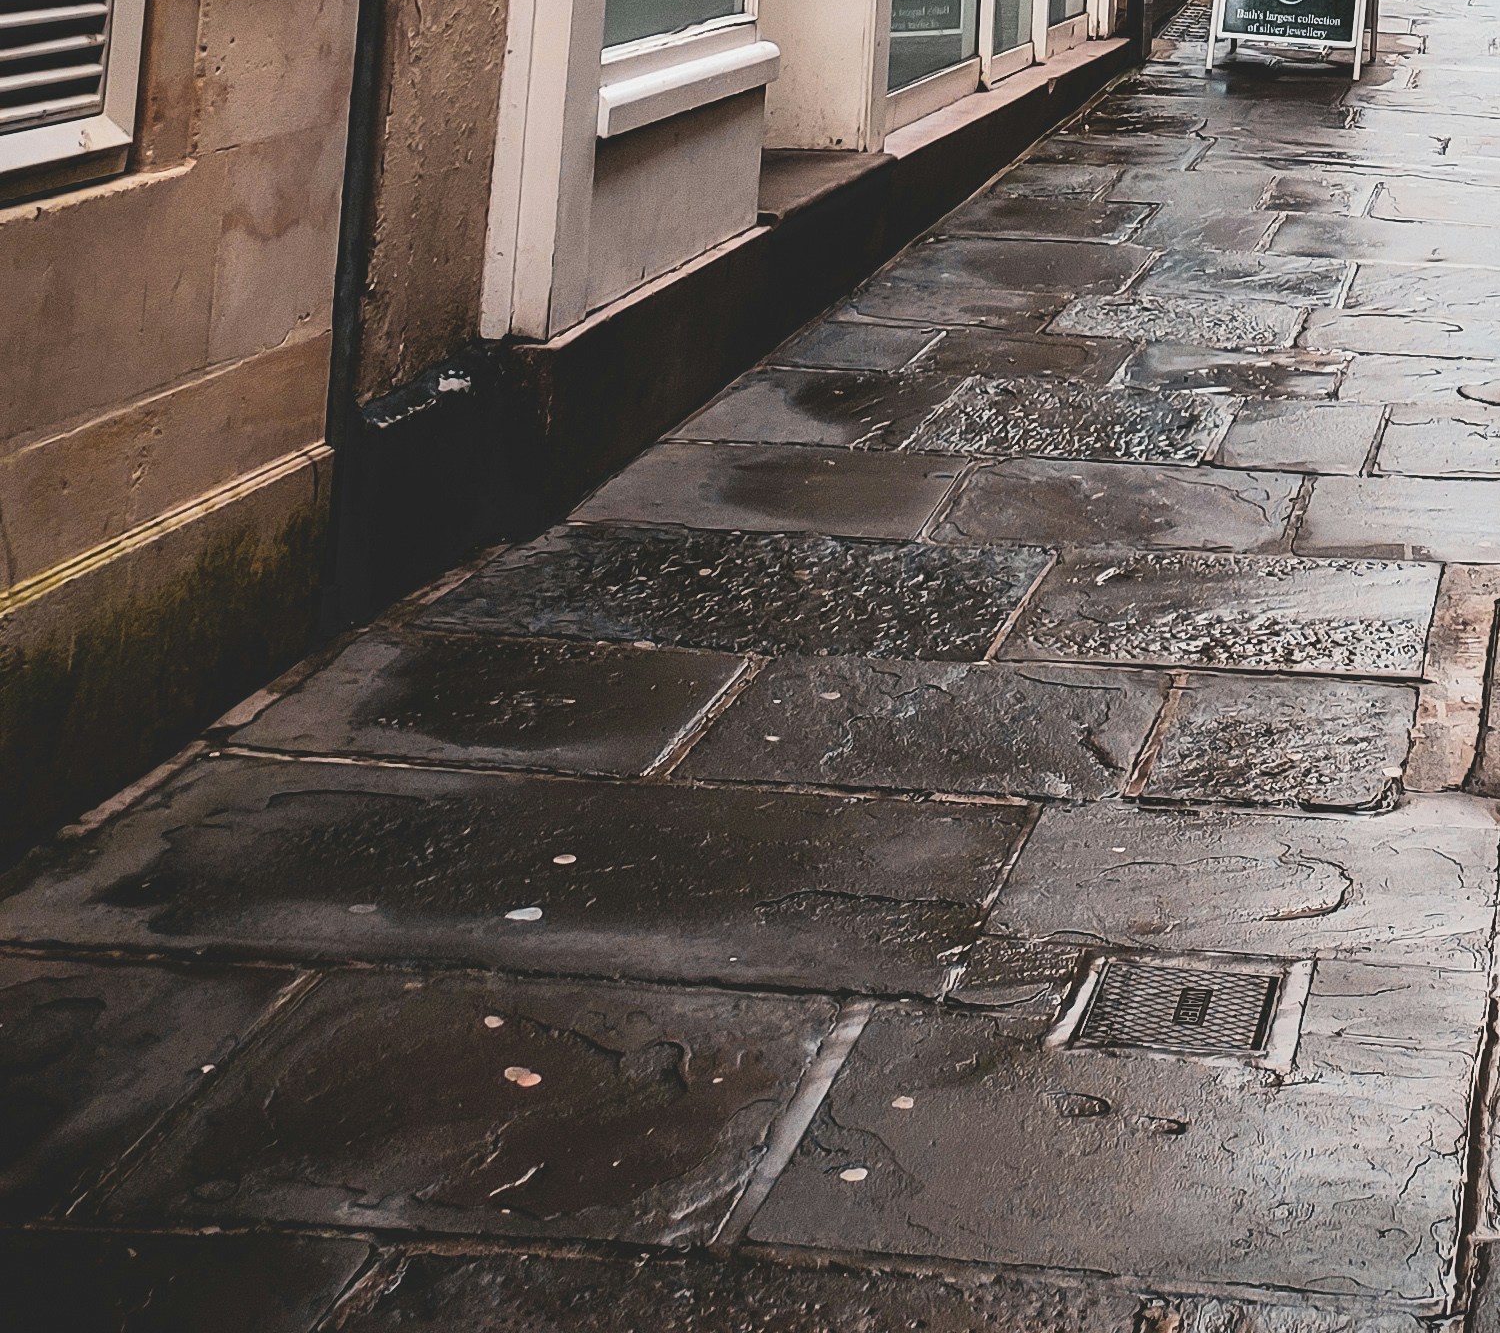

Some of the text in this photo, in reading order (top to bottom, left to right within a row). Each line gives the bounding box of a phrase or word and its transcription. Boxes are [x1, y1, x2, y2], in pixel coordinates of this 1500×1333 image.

[1236, 8, 1342, 26] Bath's largest collection
[1247, 22, 1328, 40] of silver jewellery
[1177, 991, 1207, 1023] WATER
